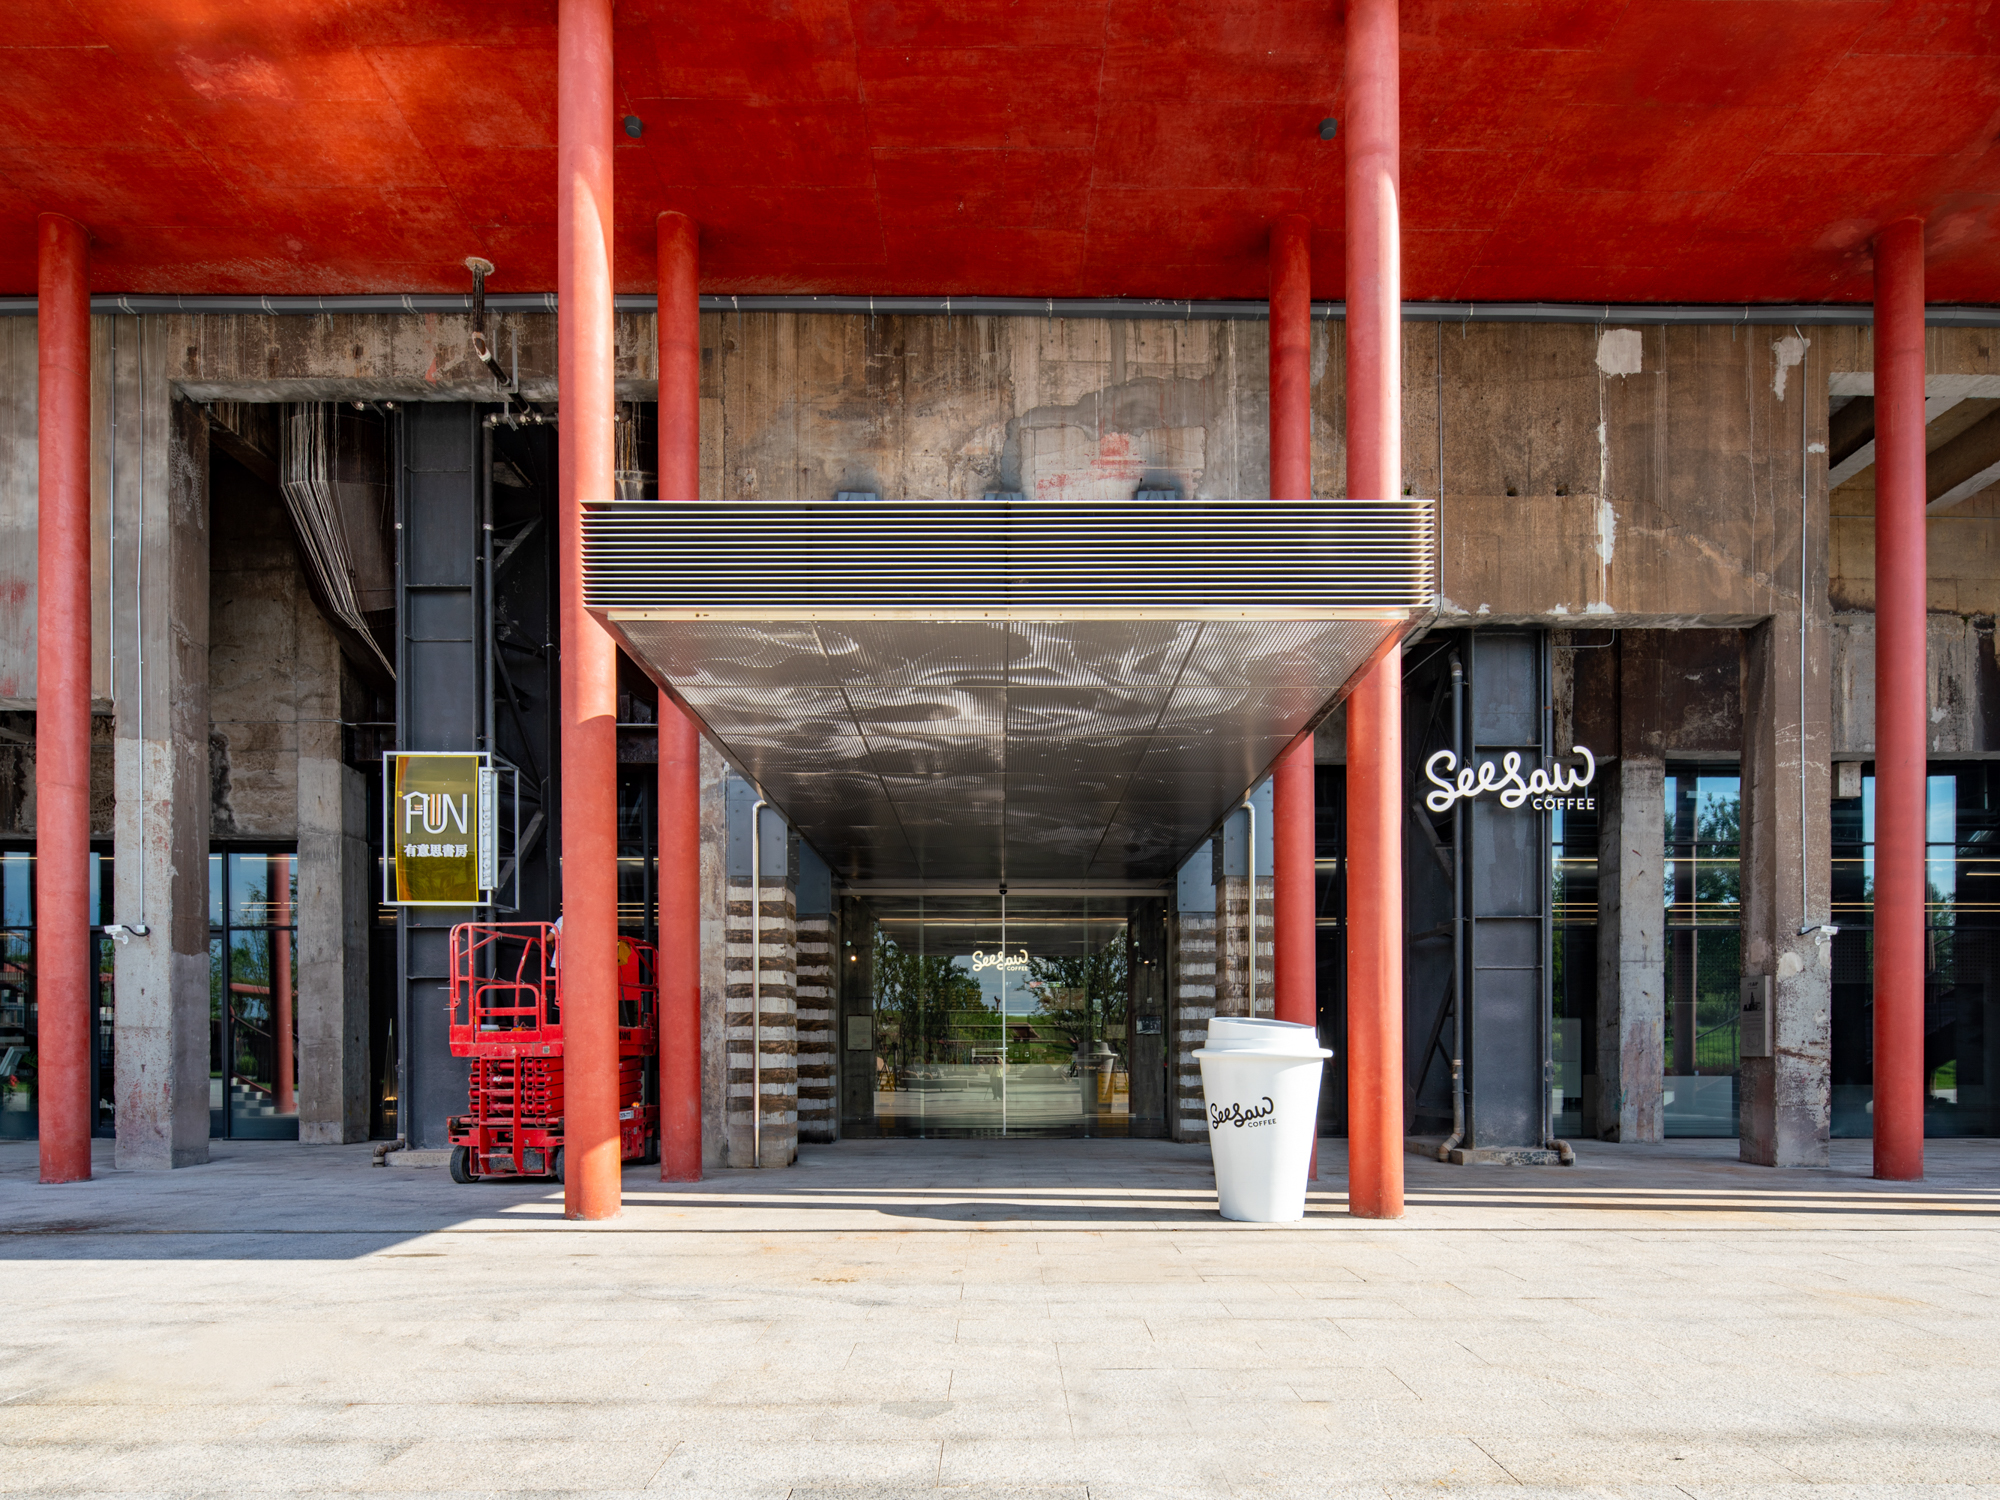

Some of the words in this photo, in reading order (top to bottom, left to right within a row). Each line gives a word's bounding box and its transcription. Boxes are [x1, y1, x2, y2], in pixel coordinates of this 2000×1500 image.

[1532, 798, 1595, 810] COFFEE
[402, 791, 468, 834] FUN
[403, 843, 468, 858] 有意思書房
[1247, 1117, 1277, 1128] COFFEE
